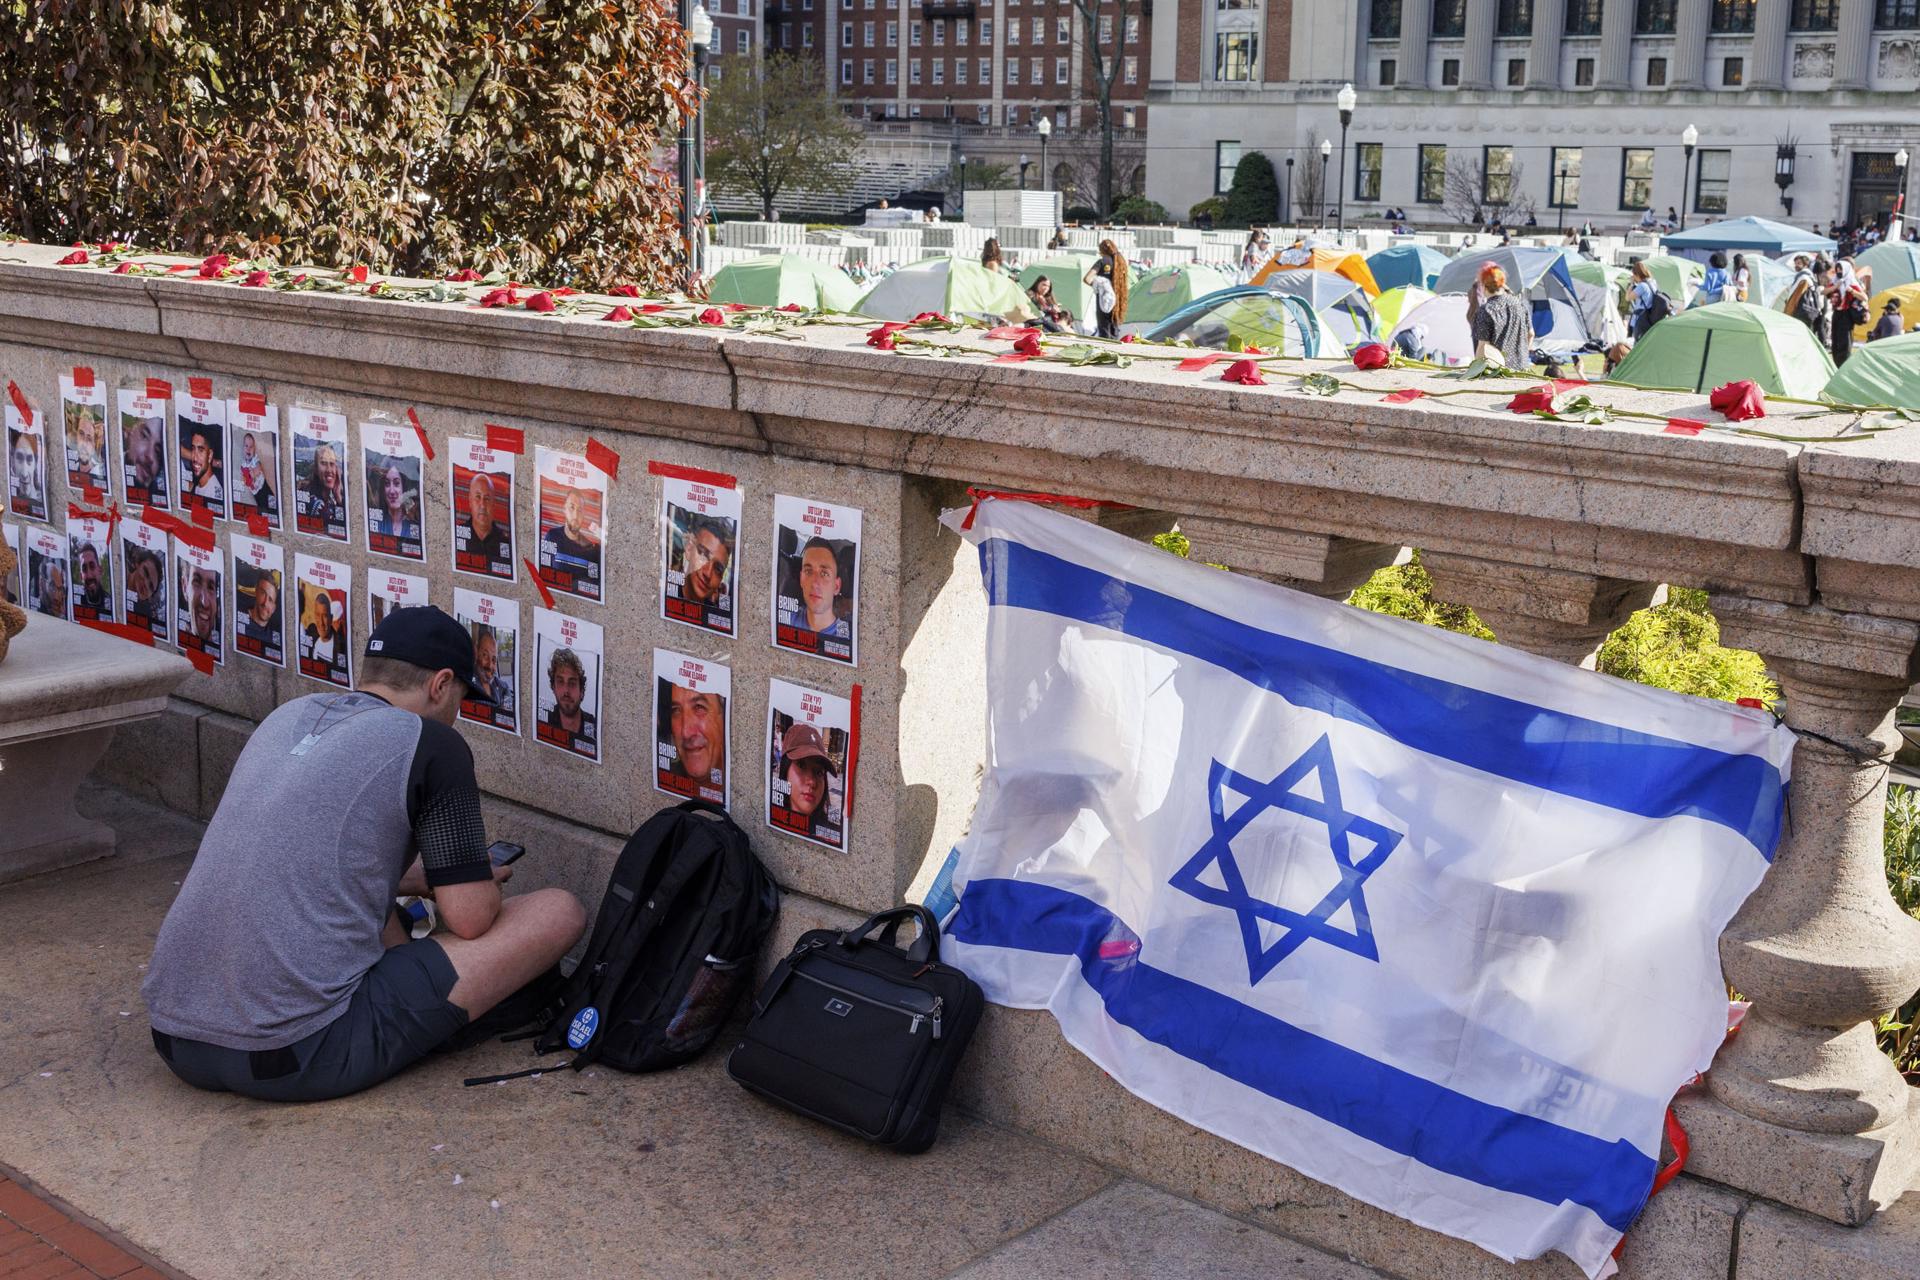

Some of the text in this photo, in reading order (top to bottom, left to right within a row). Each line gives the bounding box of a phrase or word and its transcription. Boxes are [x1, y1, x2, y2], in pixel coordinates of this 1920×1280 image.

[667, 570, 685, 586] BRING
[667, 582, 679, 598] HIM
[779, 594, 799, 613] BRING
[779, 609, 791, 625] HIM
[659, 742, 677, 759] BRING
[659, 756, 671, 771] HIM
[772, 776, 791, 796] BRING
[772, 790, 784, 807] HER
[571, 1019, 591, 1037] ISRAEL
